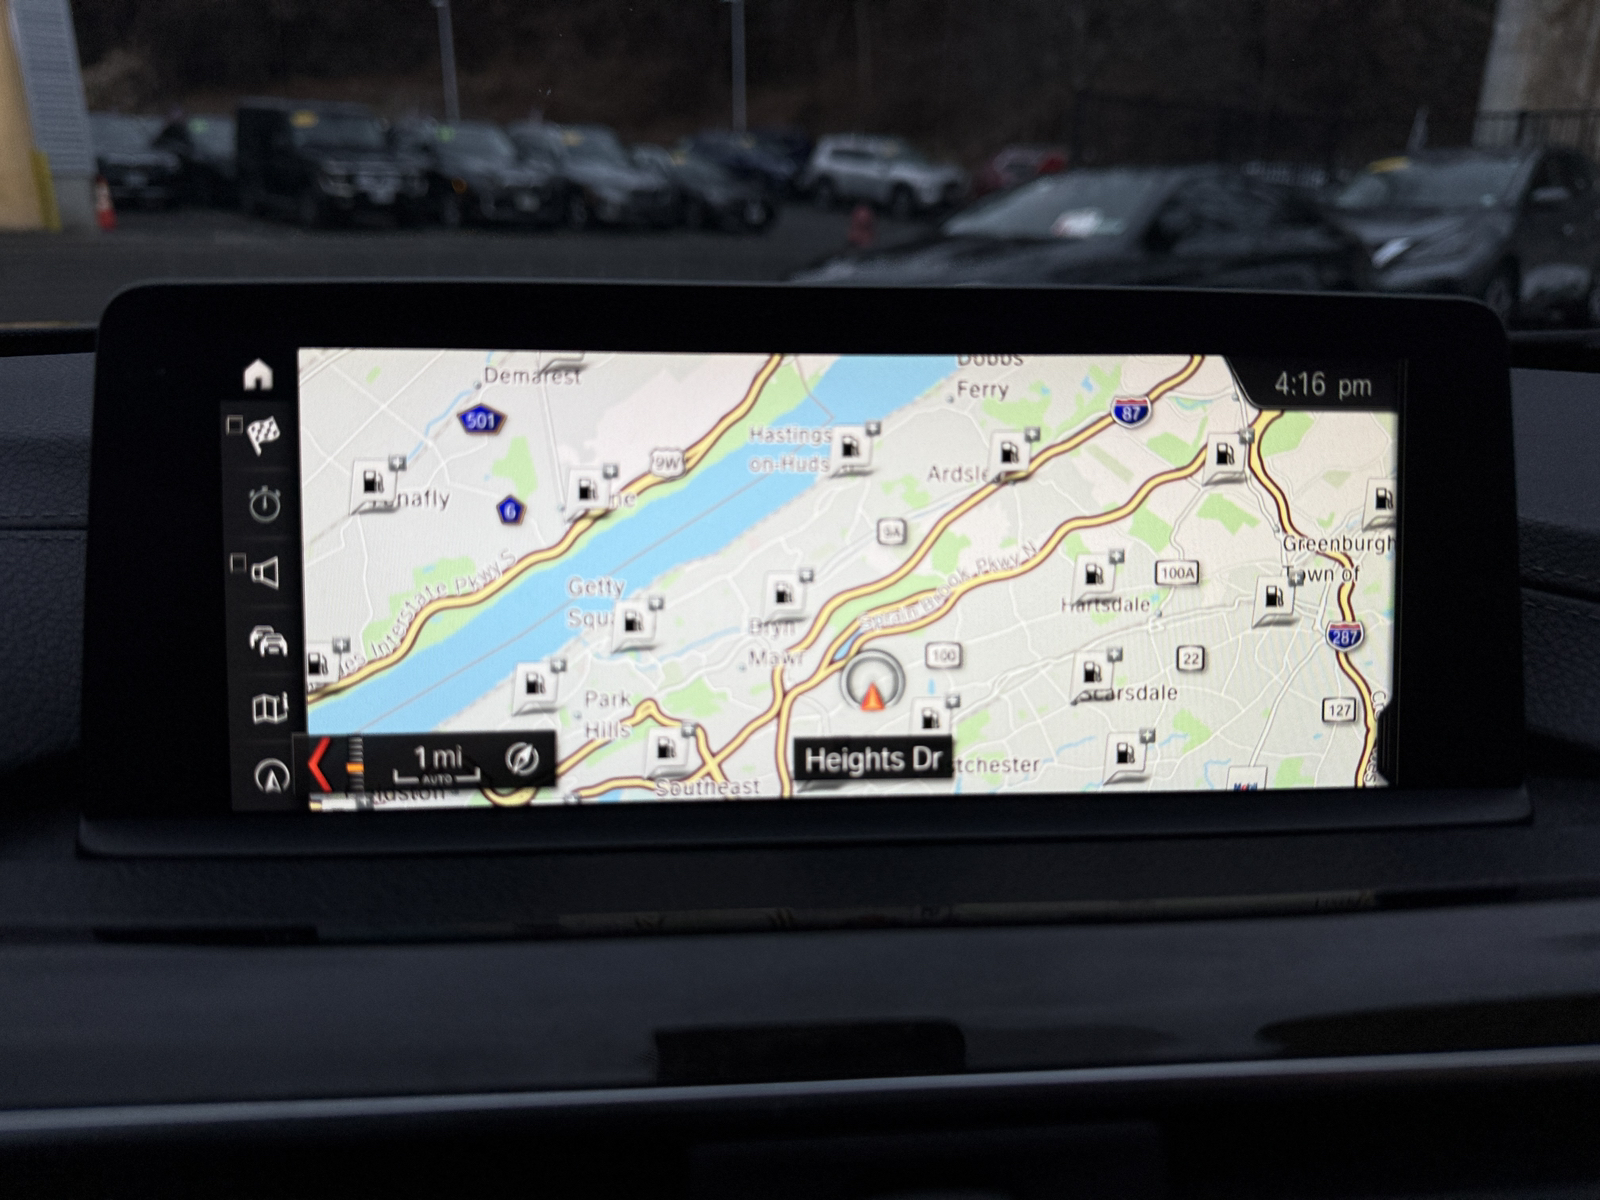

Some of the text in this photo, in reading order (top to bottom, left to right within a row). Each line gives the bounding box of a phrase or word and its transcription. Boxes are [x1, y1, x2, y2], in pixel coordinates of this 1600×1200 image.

[957, 380, 1009, 402] Ferry
[1275, 371, 1372, 399] 4:16 pm
[466, 411, 495, 429] 501
[1122, 405, 1141, 421] 87
[504, 502, 517, 520] 6
[1023, 540, 1037, 557] N
[1160, 566, 1195, 580] 100A
[1342, 565, 1360, 583] of
[568, 576, 625, 599] Getty
[370, 548, 515, 658] Interstate Pkwy S
[1331, 630, 1357, 645] 287
[932, 649, 956, 662] 100
[1183, 653, 1199, 665] 22
[585, 690, 632, 707] Park
[1330, 704, 1352, 717] 127
[585, 721, 631, 738] Hills
[414, 744, 462, 769] 1 mi
[805, 746, 943, 777] Heights Dr
[422, 773, 453, 785] AUTO
[656, 780, 760, 797] Southeast
